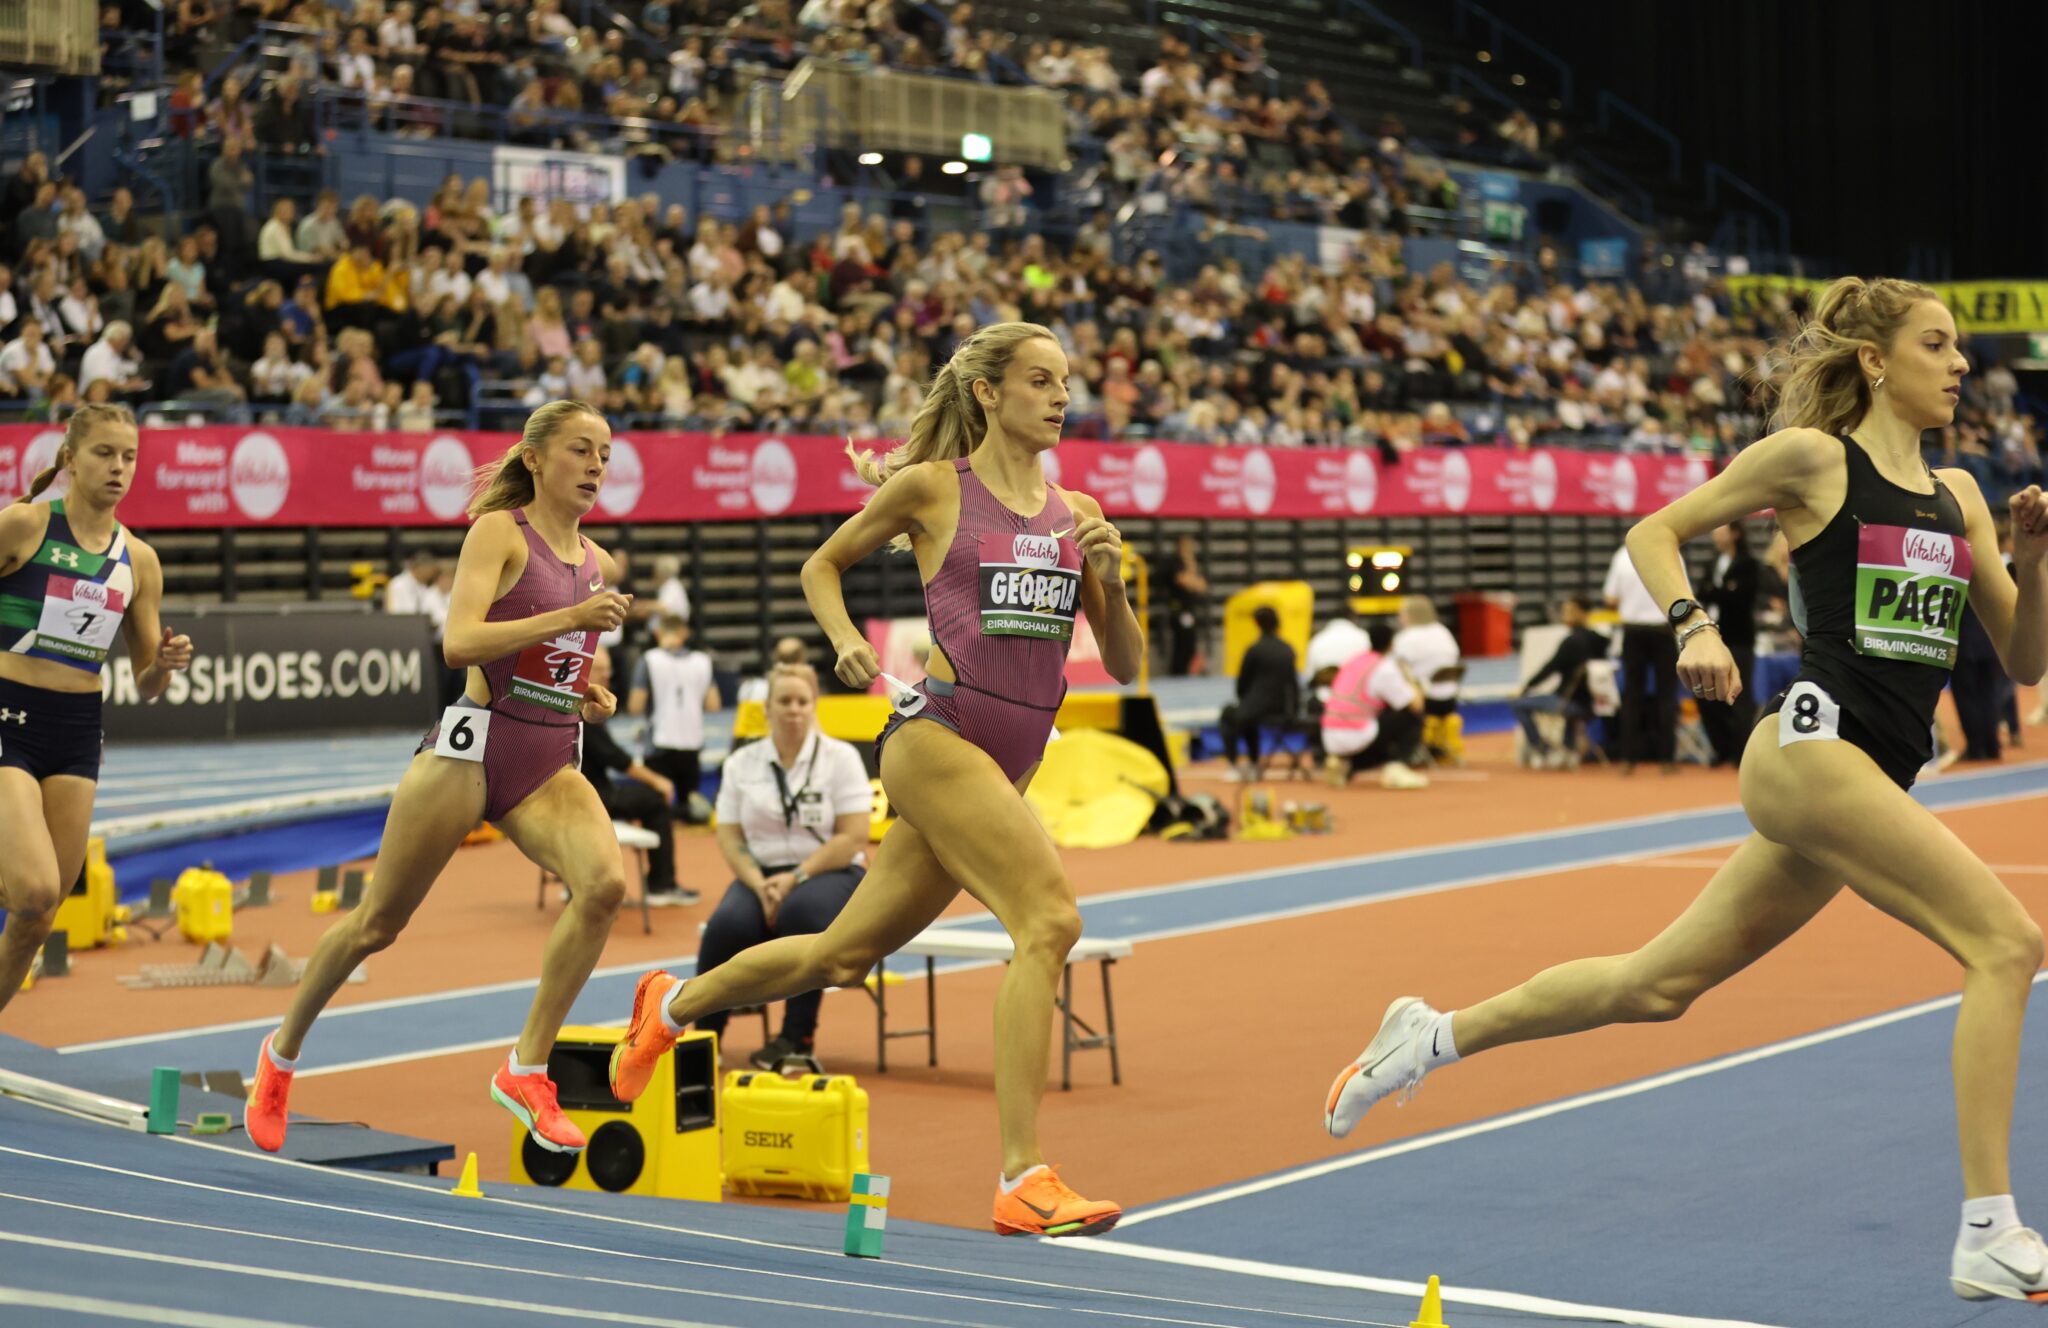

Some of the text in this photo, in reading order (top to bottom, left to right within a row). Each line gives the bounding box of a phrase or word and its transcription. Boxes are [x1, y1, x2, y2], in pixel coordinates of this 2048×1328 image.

[1015, 538, 1058, 565] Vitality
[1906, 534, 1952, 572] Vitality
[75, 584, 106, 606] Vitality
[991, 572, 1077, 611] GEORGIA
[77, 612, 96, 635] 7
[987, 620, 1060, 634] BIRMINGHAM 25
[1864, 637, 1947, 660] BIRMINGHAM 25
[555, 657, 573, 683] 6
[513, 685, 565, 707] BIRMINGHAM
[1793, 693, 1820, 734] 8
[449, 715, 475, 751] 6
